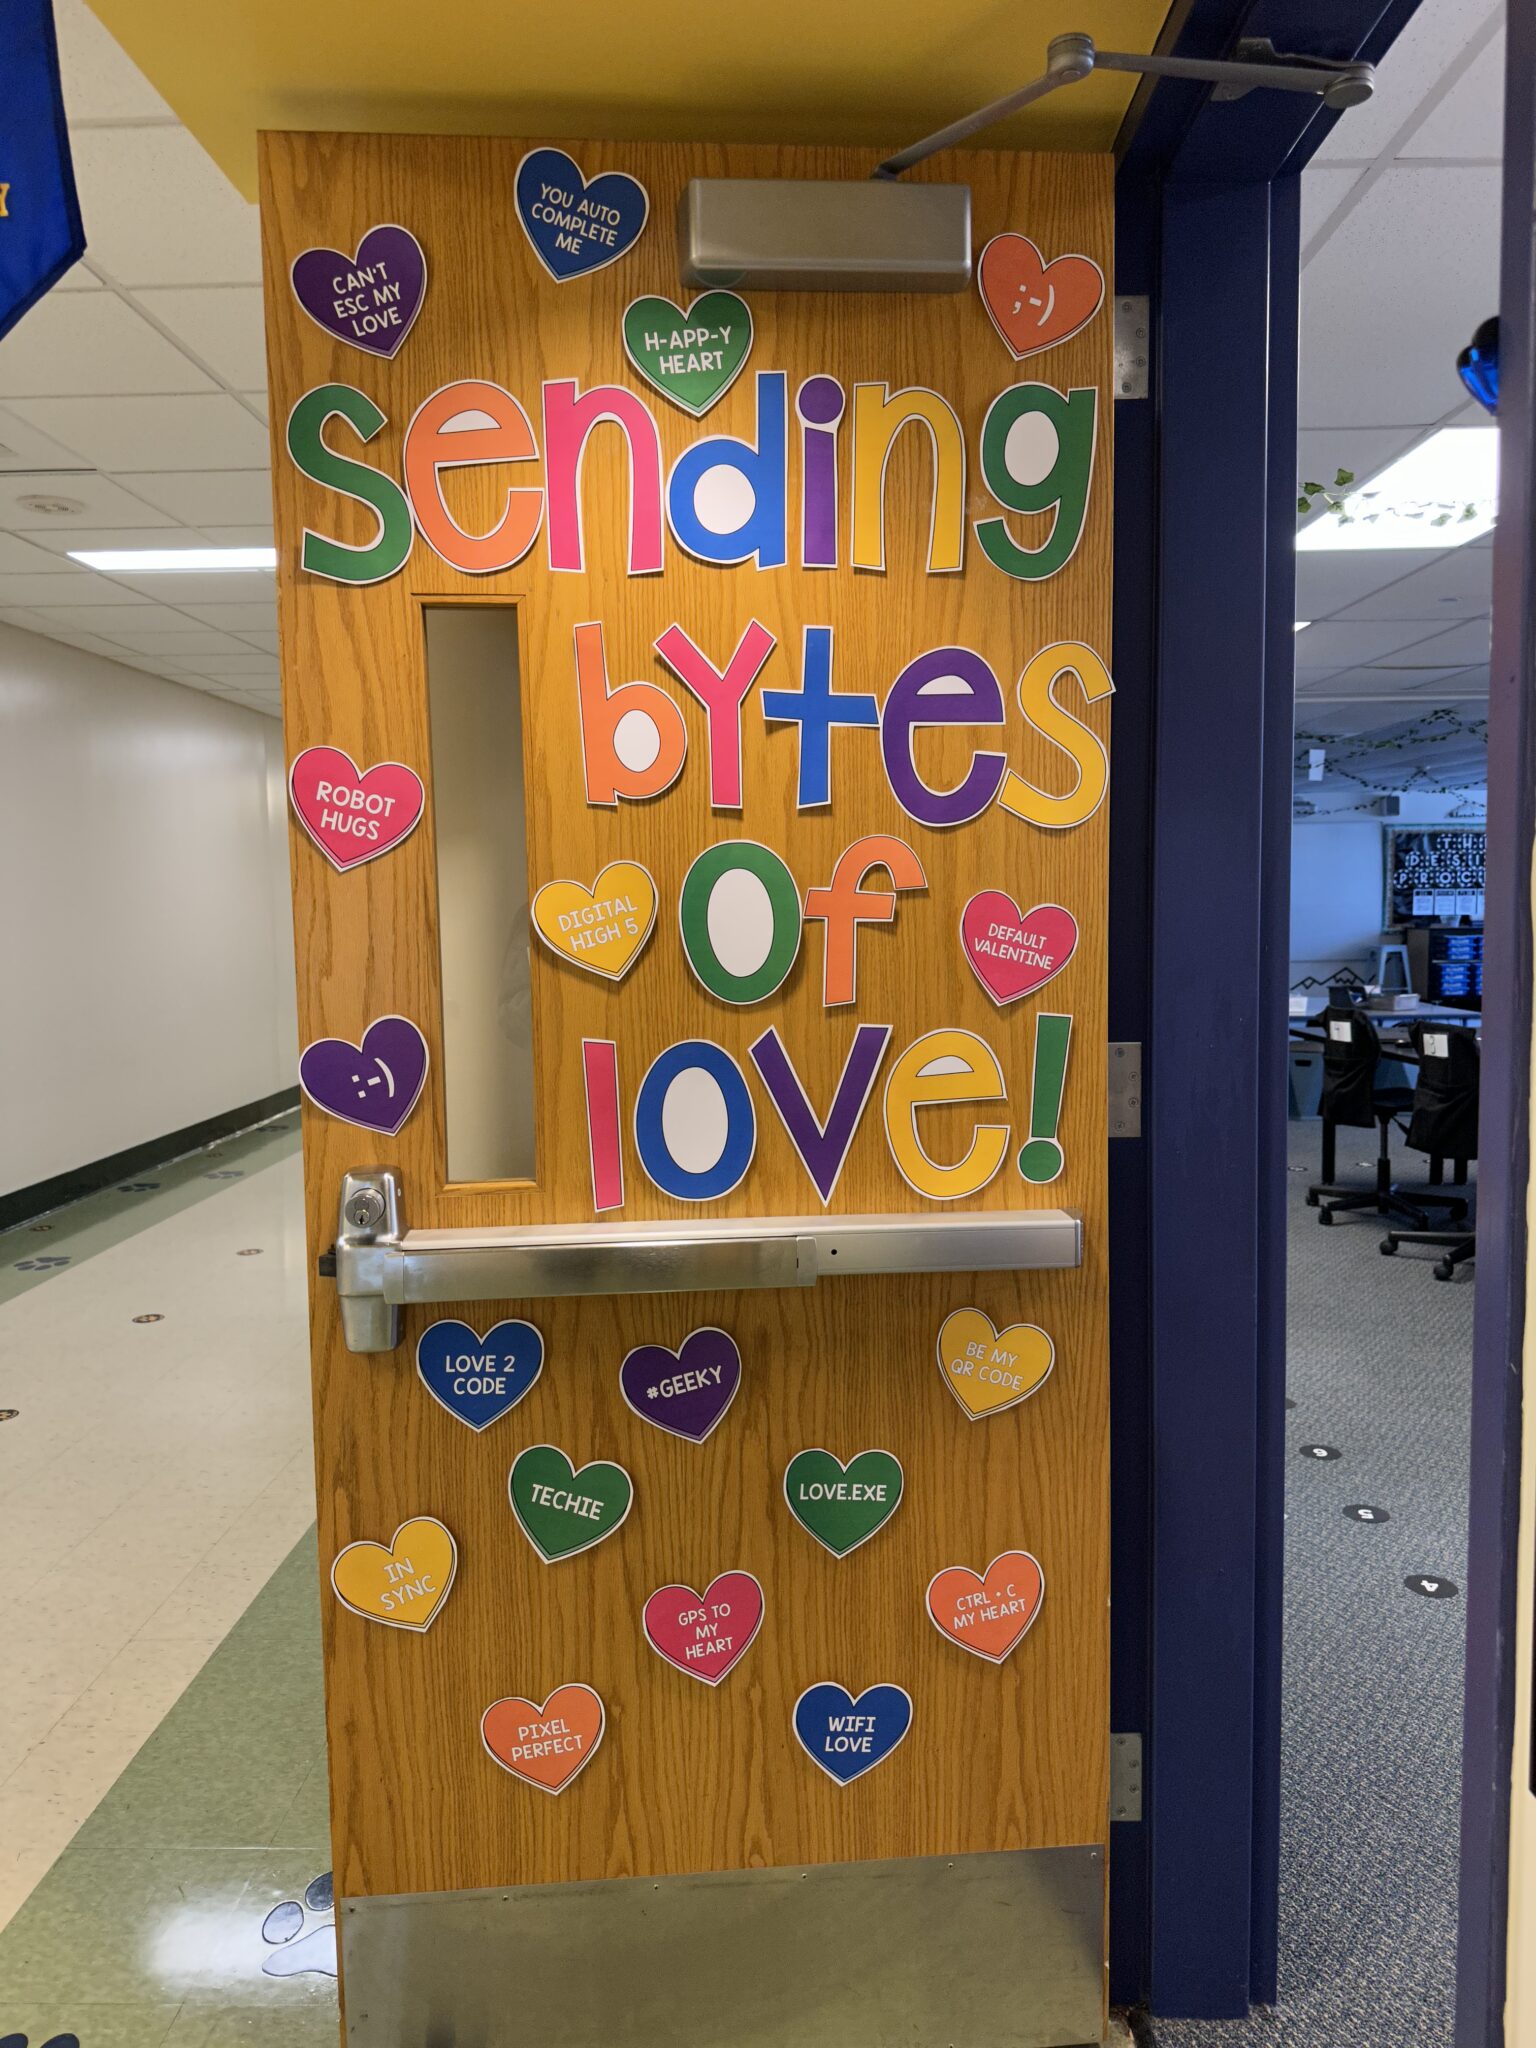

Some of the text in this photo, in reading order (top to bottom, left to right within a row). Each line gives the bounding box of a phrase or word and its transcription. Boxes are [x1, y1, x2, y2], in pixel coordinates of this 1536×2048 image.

[541, 183, 621, 226] YOU AUTO
[531, 203, 619, 247] COMPLETE
[555, 233, 584, 256] ME
[332, 262, 388, 295] CAN'T
[333, 283, 402, 319] ESC MY
[351, 307, 402, 337] LOVE
[644, 325, 732, 351] H-APP-Y
[659, 351, 724, 376] HEART
[286, 371, 1098, 584] sending
[316, 781, 396, 818] ROBOT
[320, 808, 381, 841] HUGS
[1442, 837, 1487, 850] TH
[557, 896, 639, 934] DIGITAL
[569, 917, 640, 952] HIGH 5
[987, 922, 1047, 950] DEFAULT
[973, 937, 1055, 971] VALENTINE
[445, 1355, 516, 1373] LOVE 2
[966, 1341, 1019, 1368] BE MY
[453, 1377, 507, 1395] CODE
[646, 1365, 723, 1400] #GEEKY
[951, 1358, 1024, 1392] QR CODE
[530, 1484, 605, 1521] TECHIE
[799, 1483, 888, 1502] LOVE.EXE
[1358, 1509, 1374, 1519] 5
[383, 1557, 415, 1584] IN
[379, 1575, 437, 1611] SYNC
[956, 1591, 991, 1611] CTRL
[1006, 1584, 1017, 1598] C
[1421, 1579, 1438, 1592] 4
[678, 1603, 732, 1627] GPS TO
[953, 1598, 1027, 1630] MY HEART
[695, 1622, 719, 1640] MY
[685, 1637, 734, 1660] HEART
[518, 1718, 571, 1741] PIXEL
[827, 1716, 877, 1734] WIFI
[511, 1734, 583, 1761] PERFECT
[824, 1736, 873, 1753] LOVE
